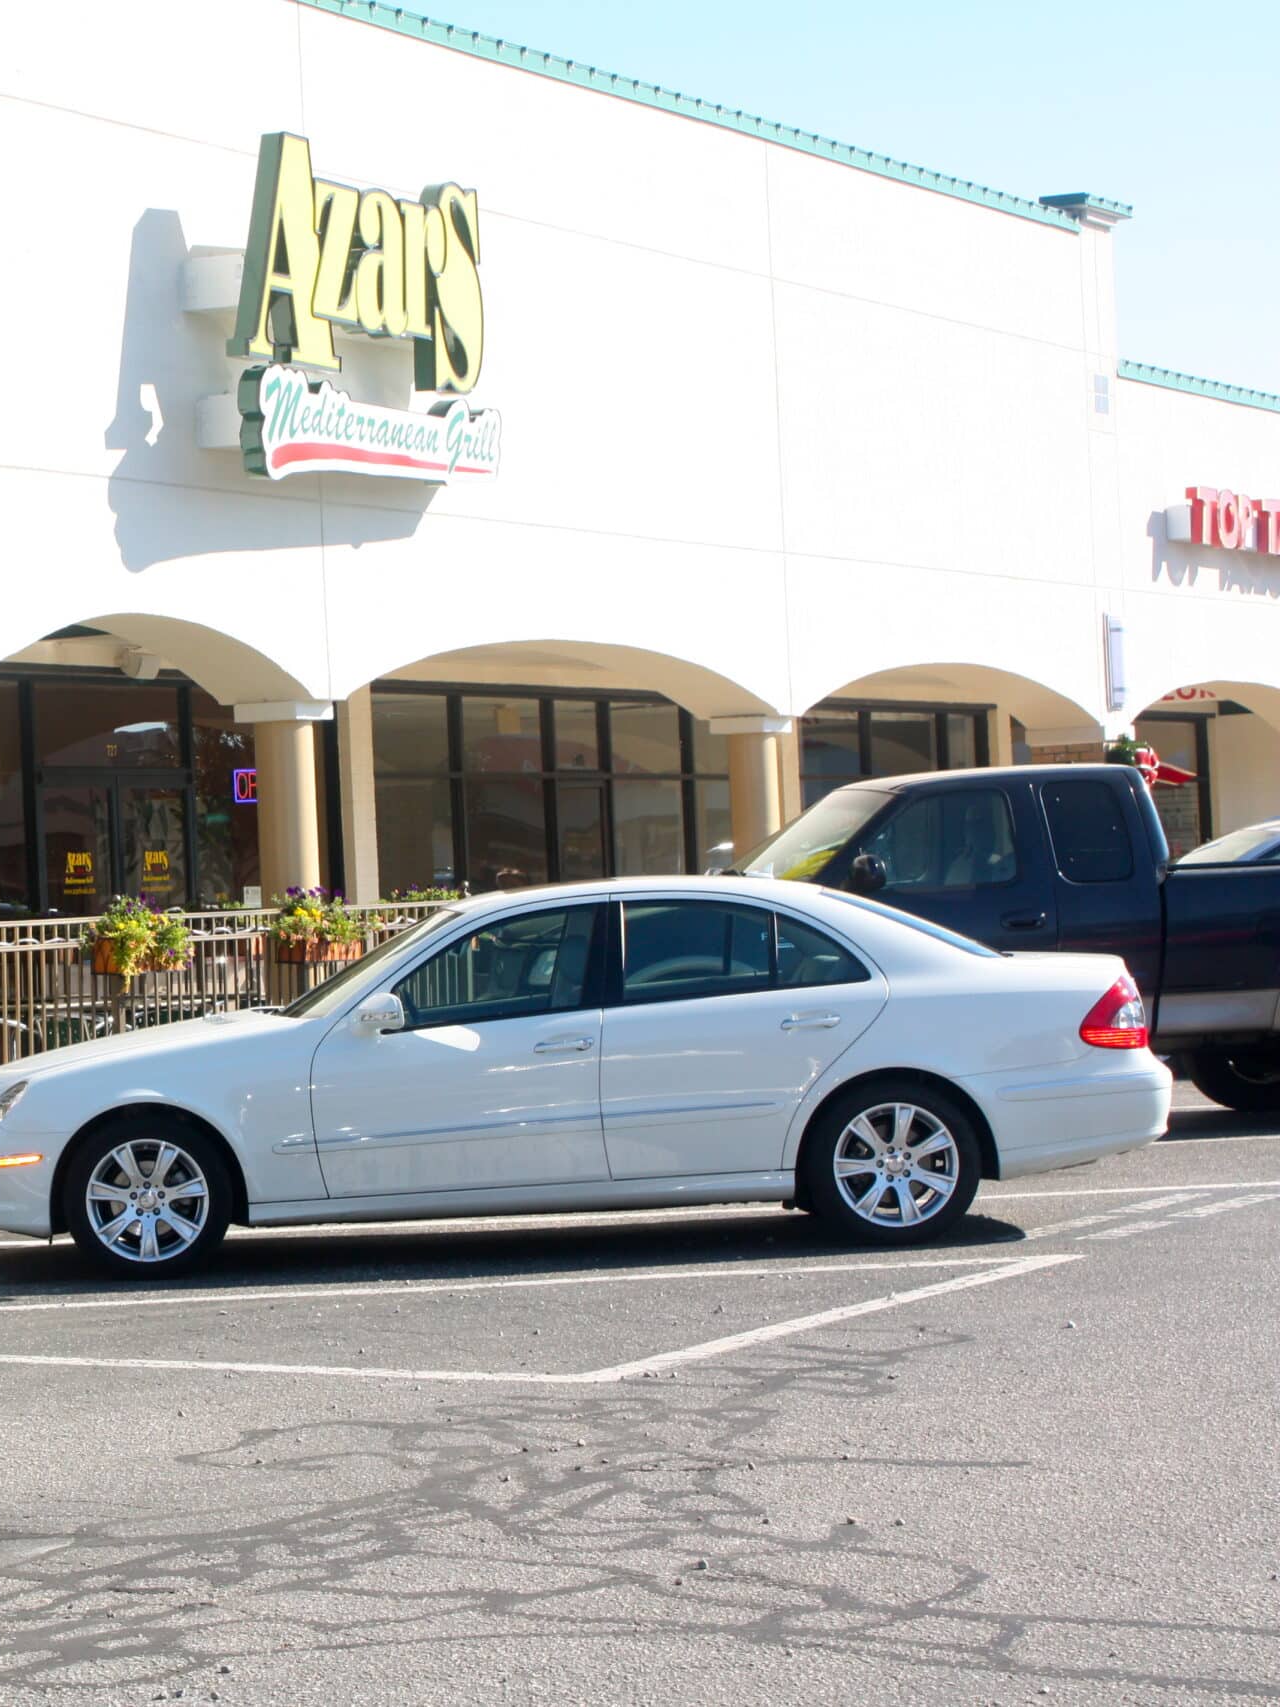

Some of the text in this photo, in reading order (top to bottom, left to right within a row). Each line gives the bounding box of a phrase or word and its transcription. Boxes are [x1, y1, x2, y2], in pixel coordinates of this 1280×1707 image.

[265, 375, 497, 473] Mediterranean Grill
[1186, 486, 1254, 551] TOP
[236, 771, 257, 799] OP
